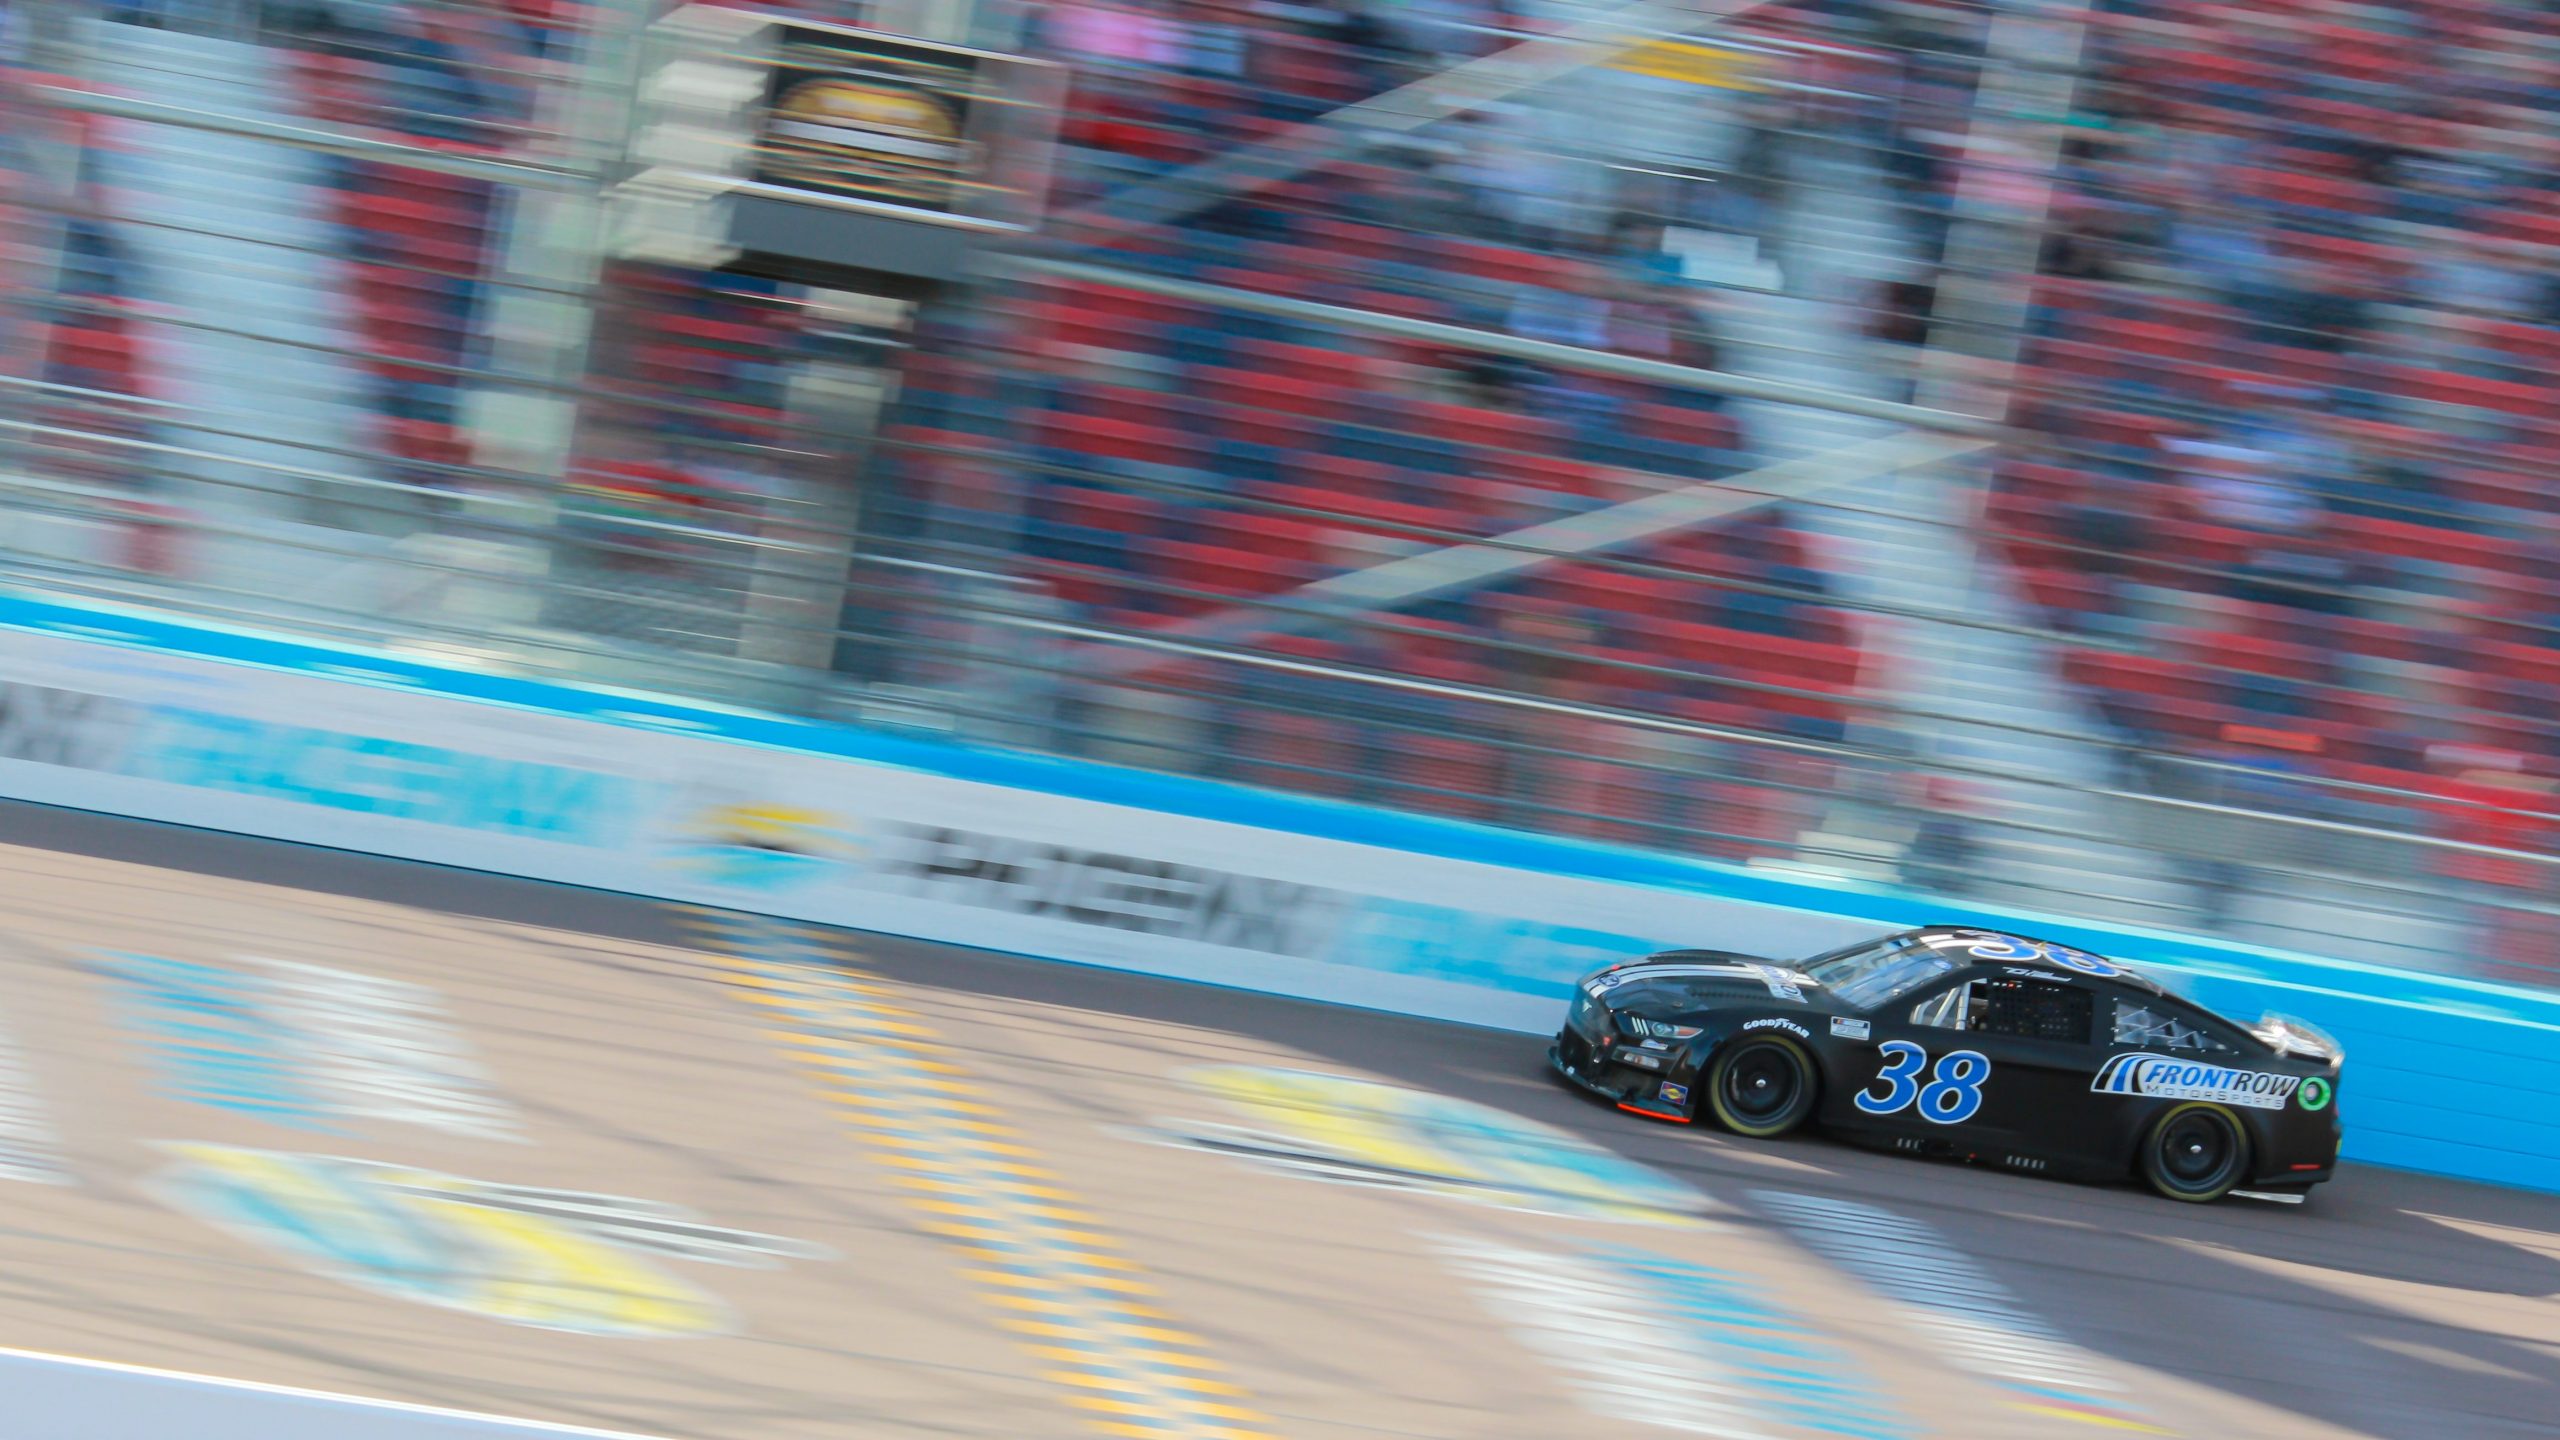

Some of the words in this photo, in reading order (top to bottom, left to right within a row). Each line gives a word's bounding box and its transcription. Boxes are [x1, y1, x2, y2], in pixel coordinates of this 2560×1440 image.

[1955, 929, 2124, 977] 38
[1743, 1018, 1810, 1039] GOODYEAR
[1853, 1040, 1991, 1124] 38
